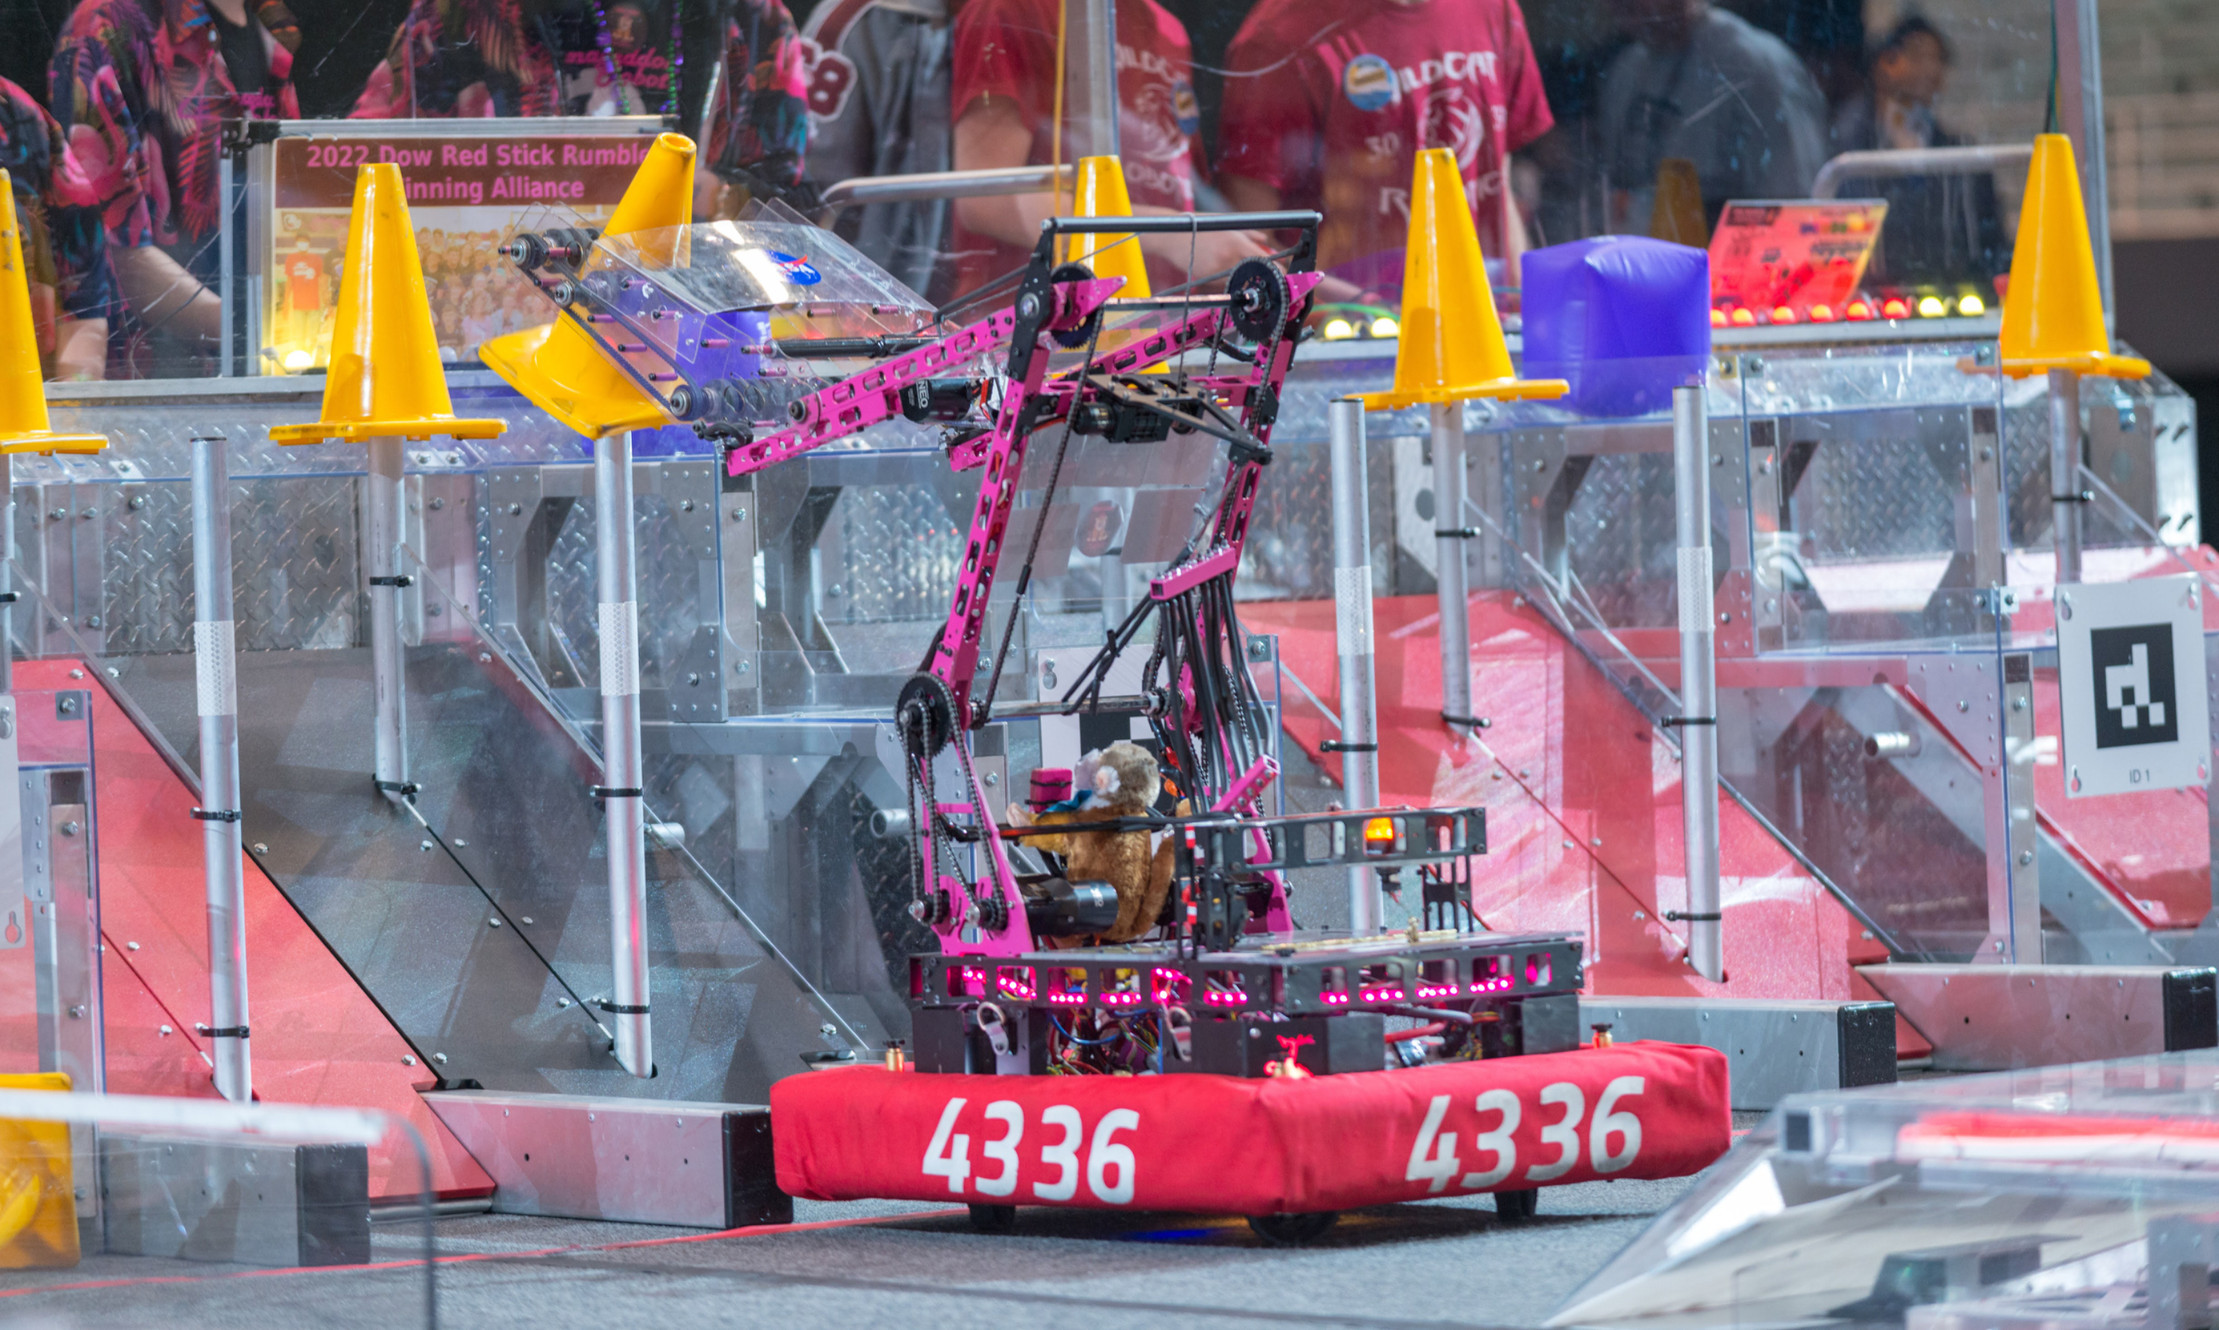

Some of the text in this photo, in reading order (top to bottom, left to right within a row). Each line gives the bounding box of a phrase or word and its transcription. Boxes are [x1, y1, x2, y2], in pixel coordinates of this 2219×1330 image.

[307, 145, 369, 168] 2022
[379, 145, 432, 167] Dow
[442, 144, 487, 167] Red
[496, 144, 555, 167] Stick
[402, 176, 585, 205] inning Alliance
[2129, 769, 2150, 784] ID 1
[1405, 1075, 1646, 1193] 4336
[922, 1097, 1140, 1204] 4336
